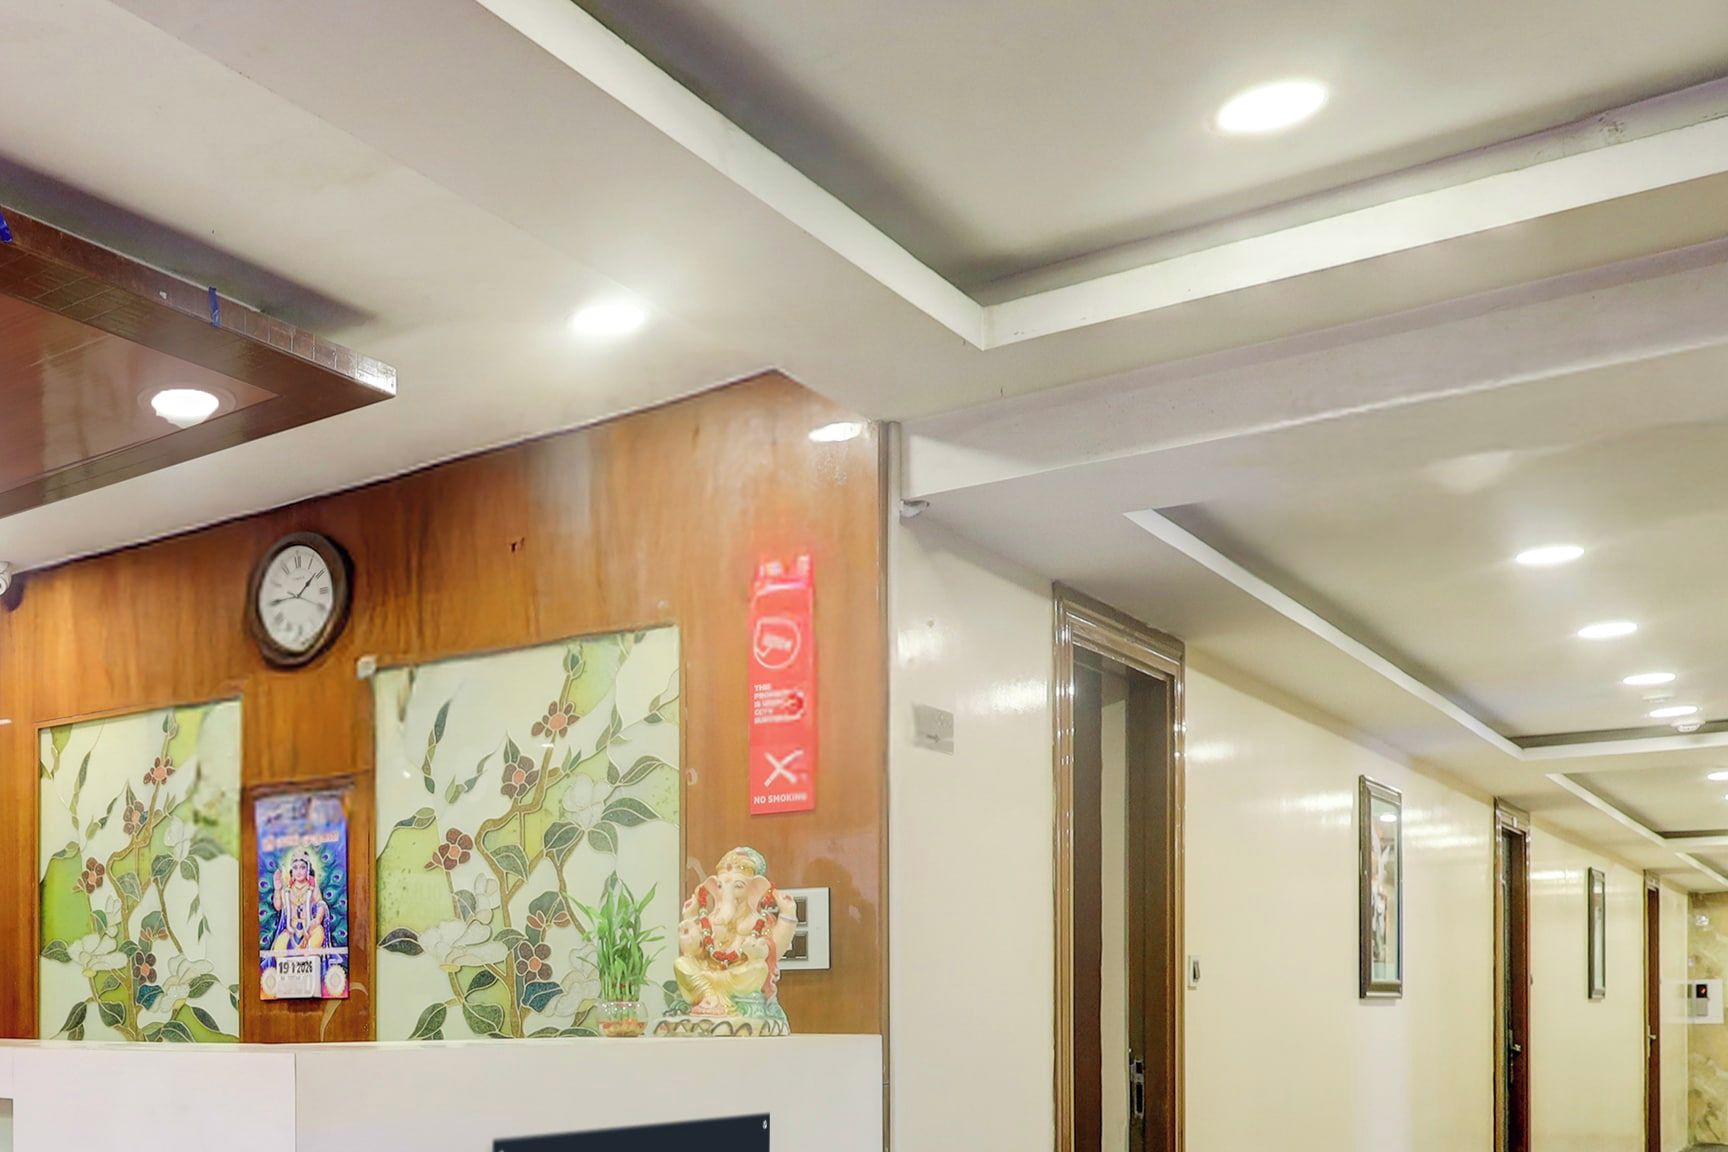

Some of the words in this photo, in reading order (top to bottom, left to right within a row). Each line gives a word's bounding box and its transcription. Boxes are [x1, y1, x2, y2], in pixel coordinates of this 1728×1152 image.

[753, 795, 766, 805] NO
[767, 792, 807, 804] SMOKING
[278, 961, 290, 974] 19
